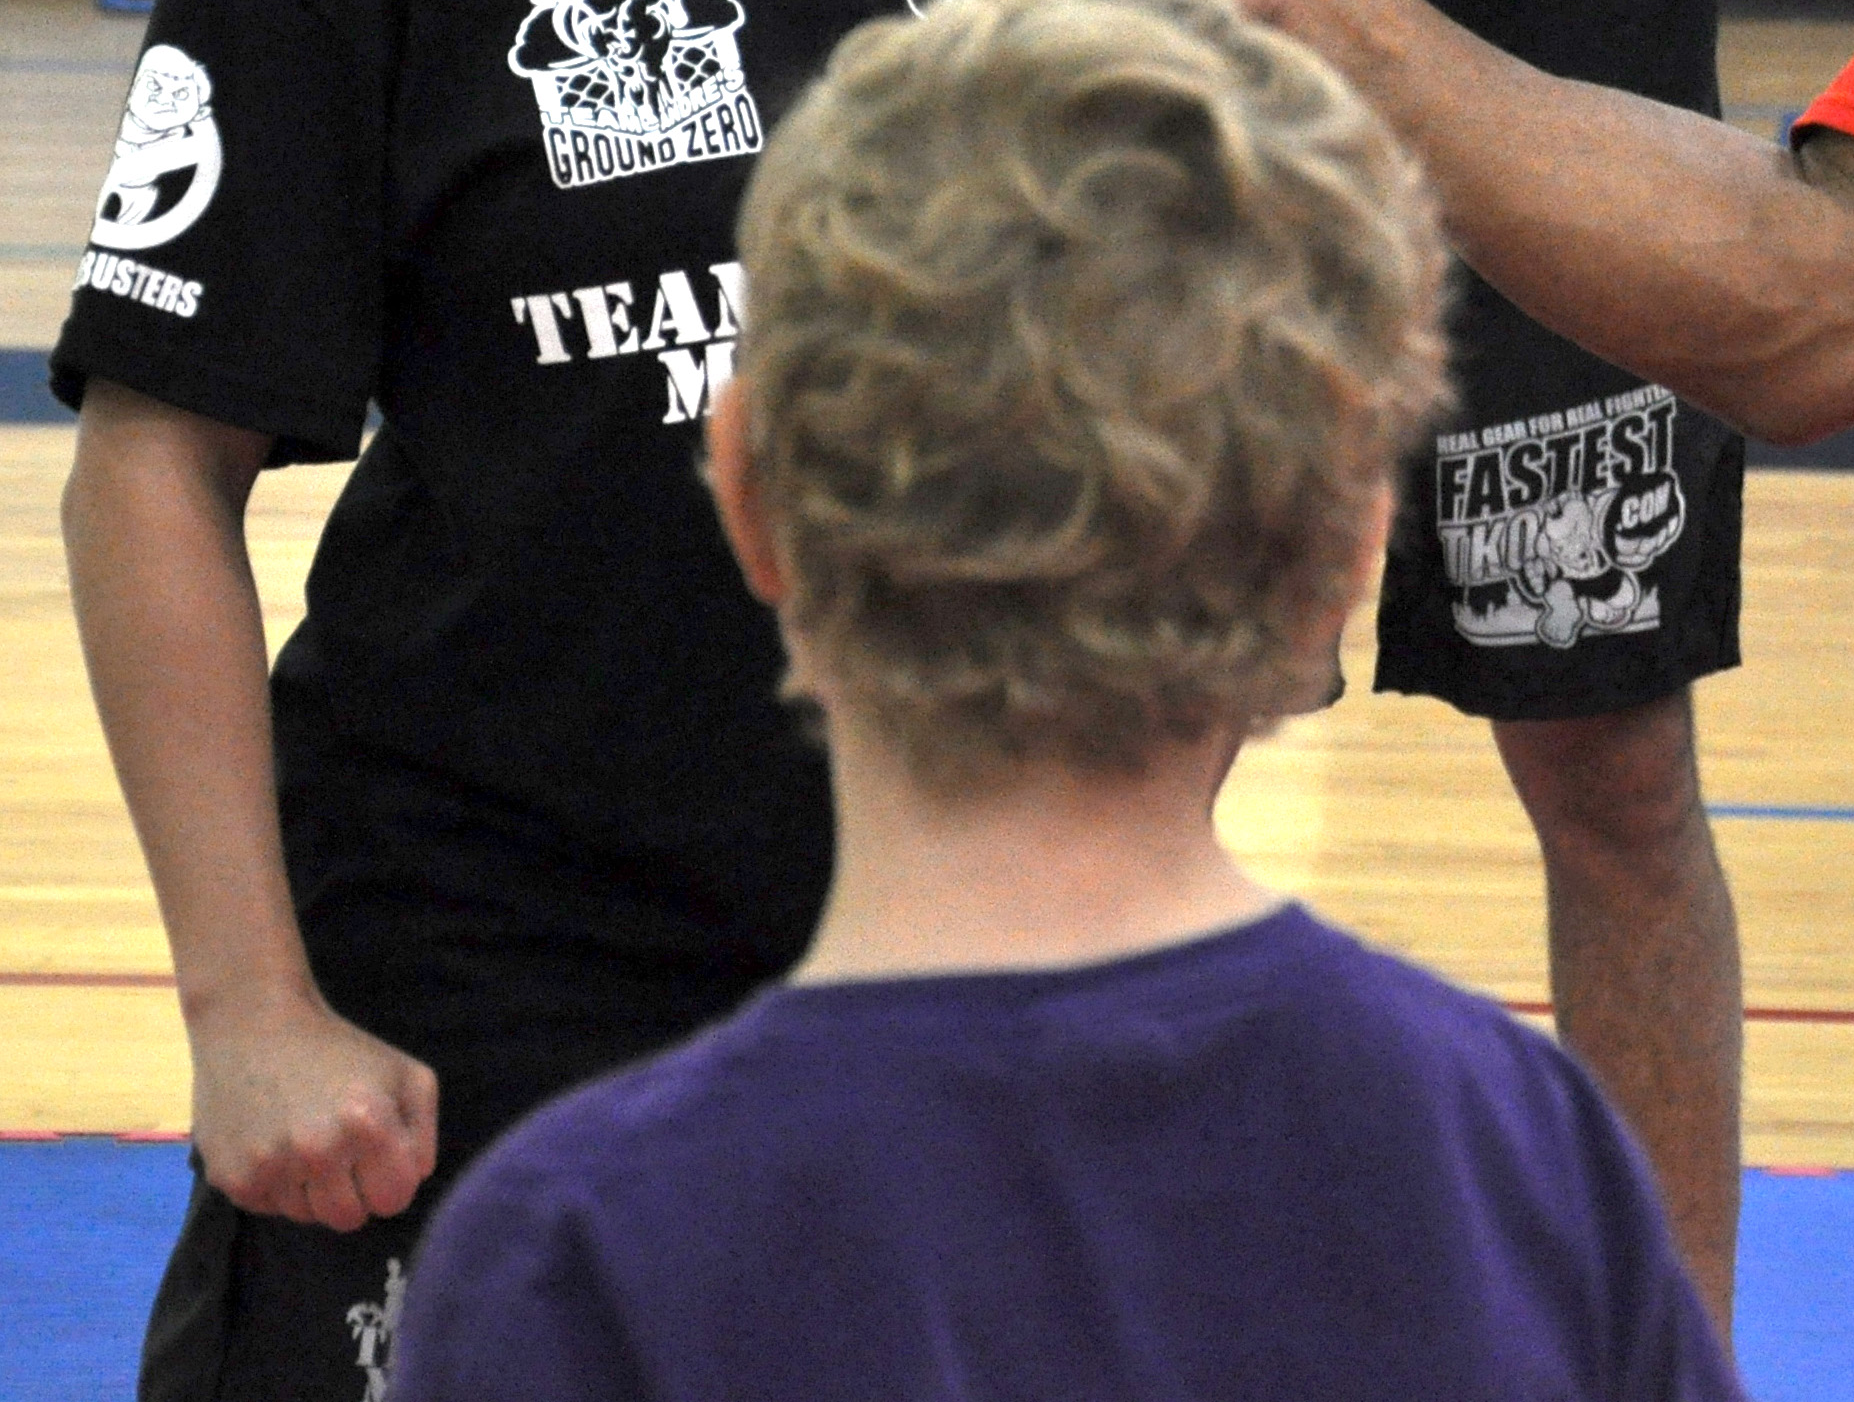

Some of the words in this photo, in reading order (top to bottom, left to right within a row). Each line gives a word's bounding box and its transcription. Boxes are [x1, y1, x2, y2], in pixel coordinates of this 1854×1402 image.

[549, 127, 676, 185] GROUND
[682, 94, 759, 158] ZERO
[1437, 396, 1677, 527] FASTEST
[1528, 411, 1565, 437] FOR
